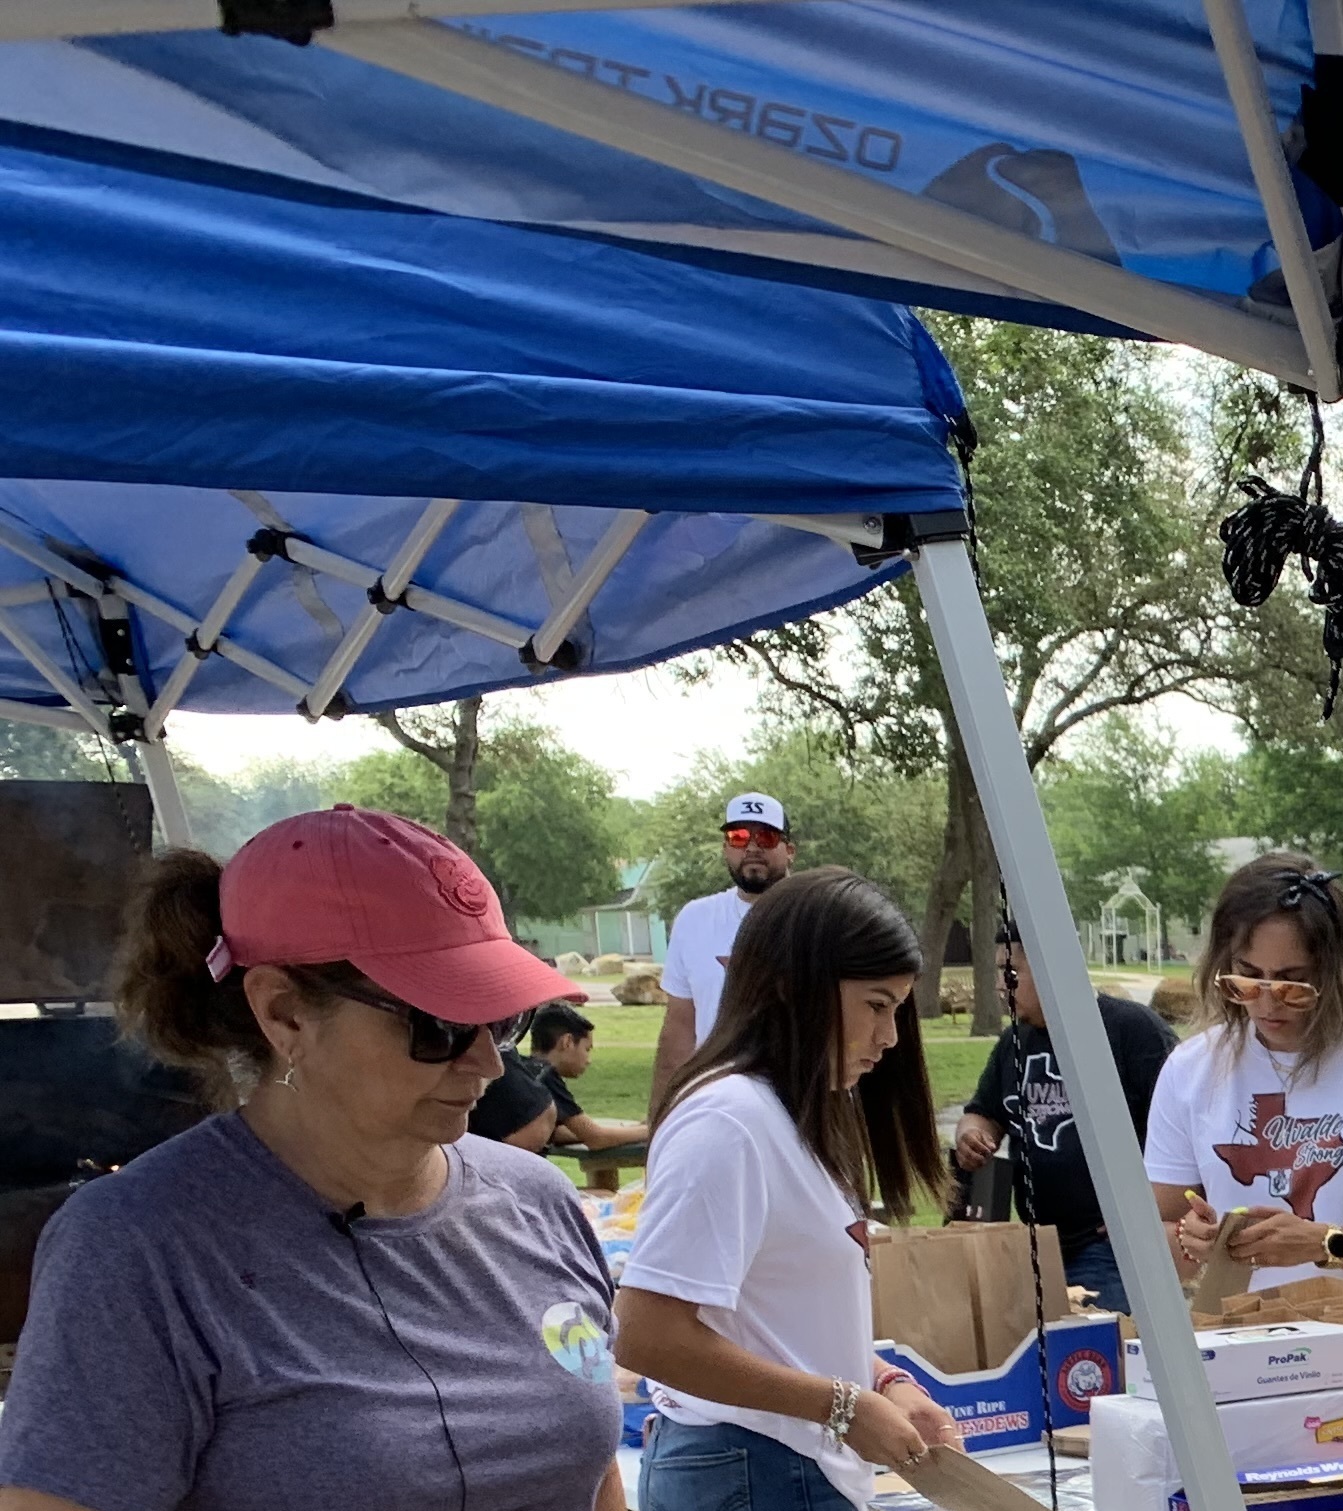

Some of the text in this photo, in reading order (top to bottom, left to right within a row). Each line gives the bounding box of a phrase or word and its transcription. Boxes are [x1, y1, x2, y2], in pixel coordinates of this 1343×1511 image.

[1027, 1082, 1069, 1103] UVAL
[1267, 1352, 1307, 1366] ProPak
[1257, 1373, 1288, 1385] Guantes
[1246, 1464, 1319, 1483] Reynolds
